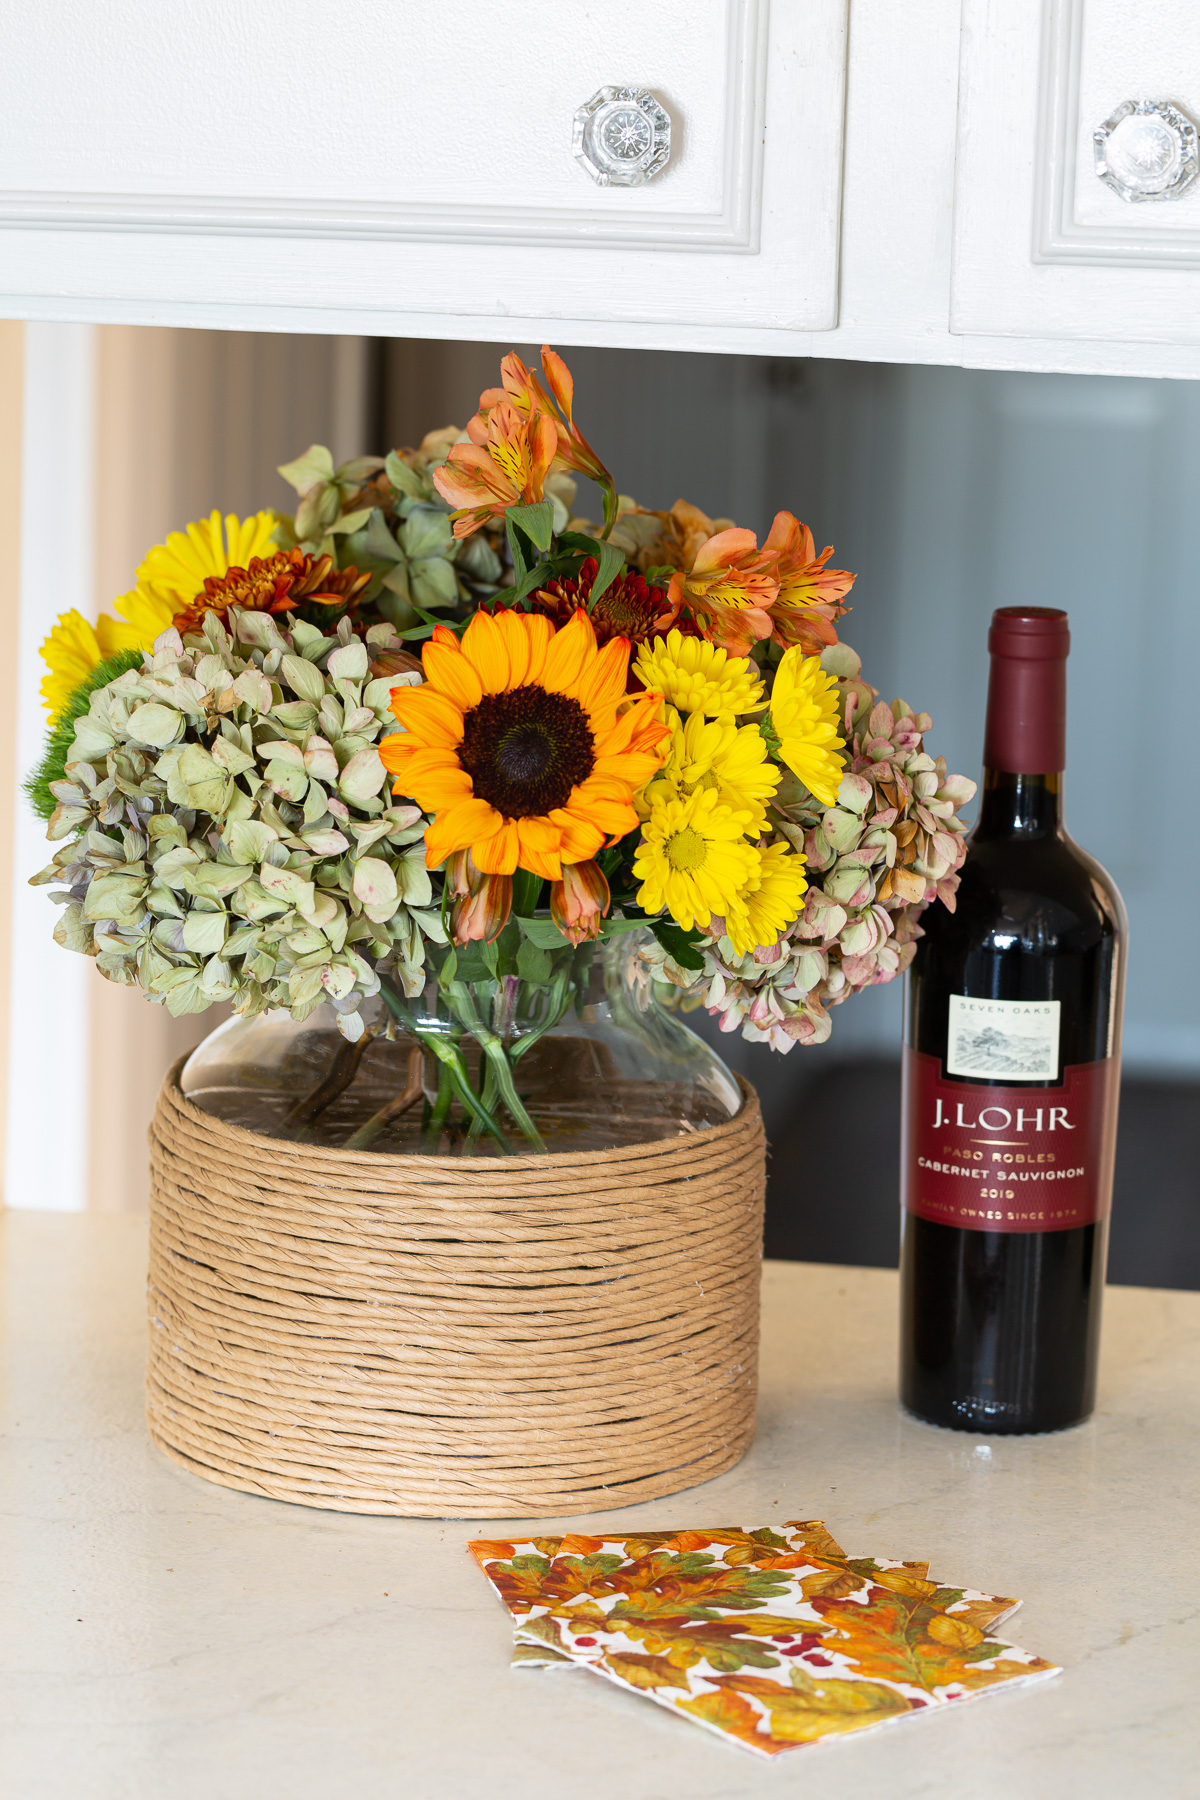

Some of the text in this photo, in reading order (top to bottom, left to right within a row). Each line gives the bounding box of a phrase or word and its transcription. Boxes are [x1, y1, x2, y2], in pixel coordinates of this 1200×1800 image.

[960, 1002, 1051, 1014] SEVEN OAKS
[943, 1145, 1056, 1164] PASO ROBLES
[917, 1156, 1085, 1181] CABERNET SAUVIGNON
[979, 1187, 1015, 1200] 2019
[959, 1207, 1003, 1220] OWNED
[1006, 1210, 1045, 1220] SINCE
